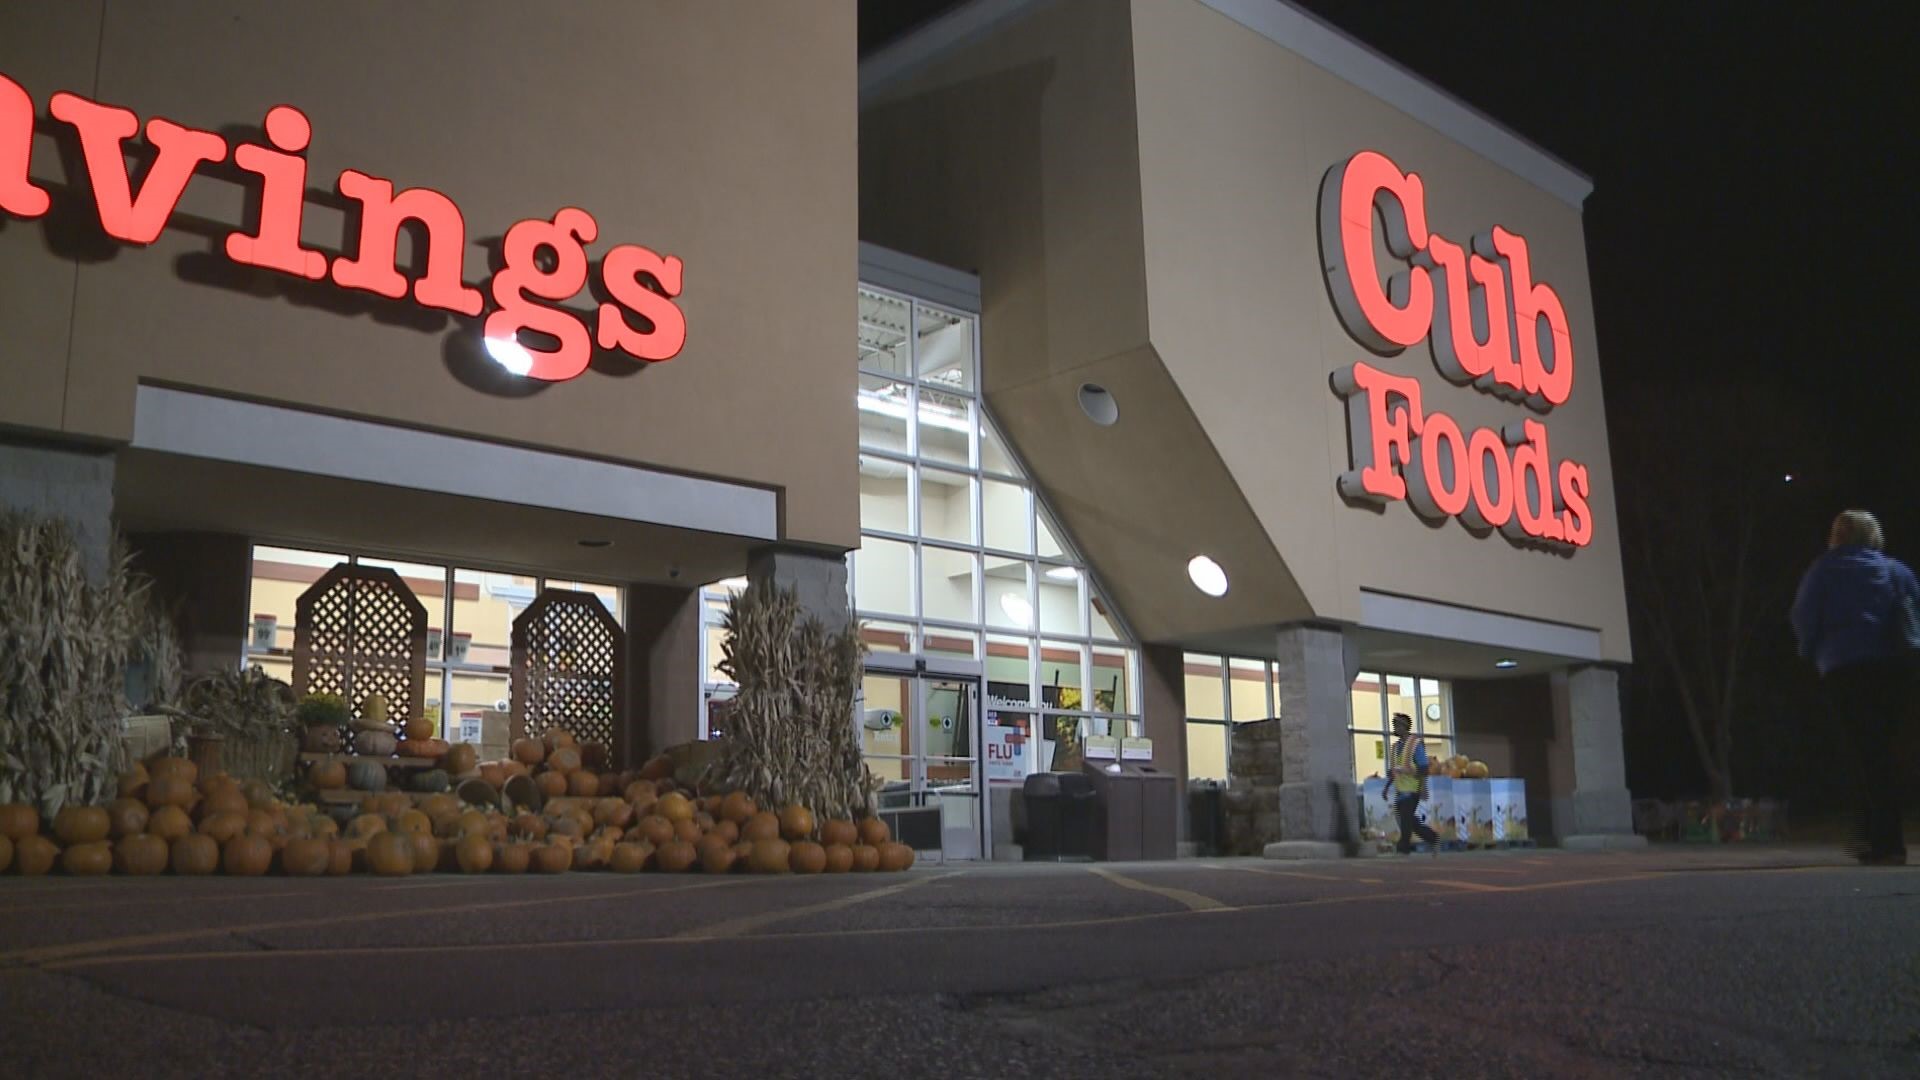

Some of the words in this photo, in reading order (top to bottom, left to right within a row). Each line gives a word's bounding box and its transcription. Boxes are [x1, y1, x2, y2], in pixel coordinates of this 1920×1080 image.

[1339, 150, 1574, 405] Cub
[1352, 361, 1594, 547] Foods
[988, 743, 1013, 760] FLU
